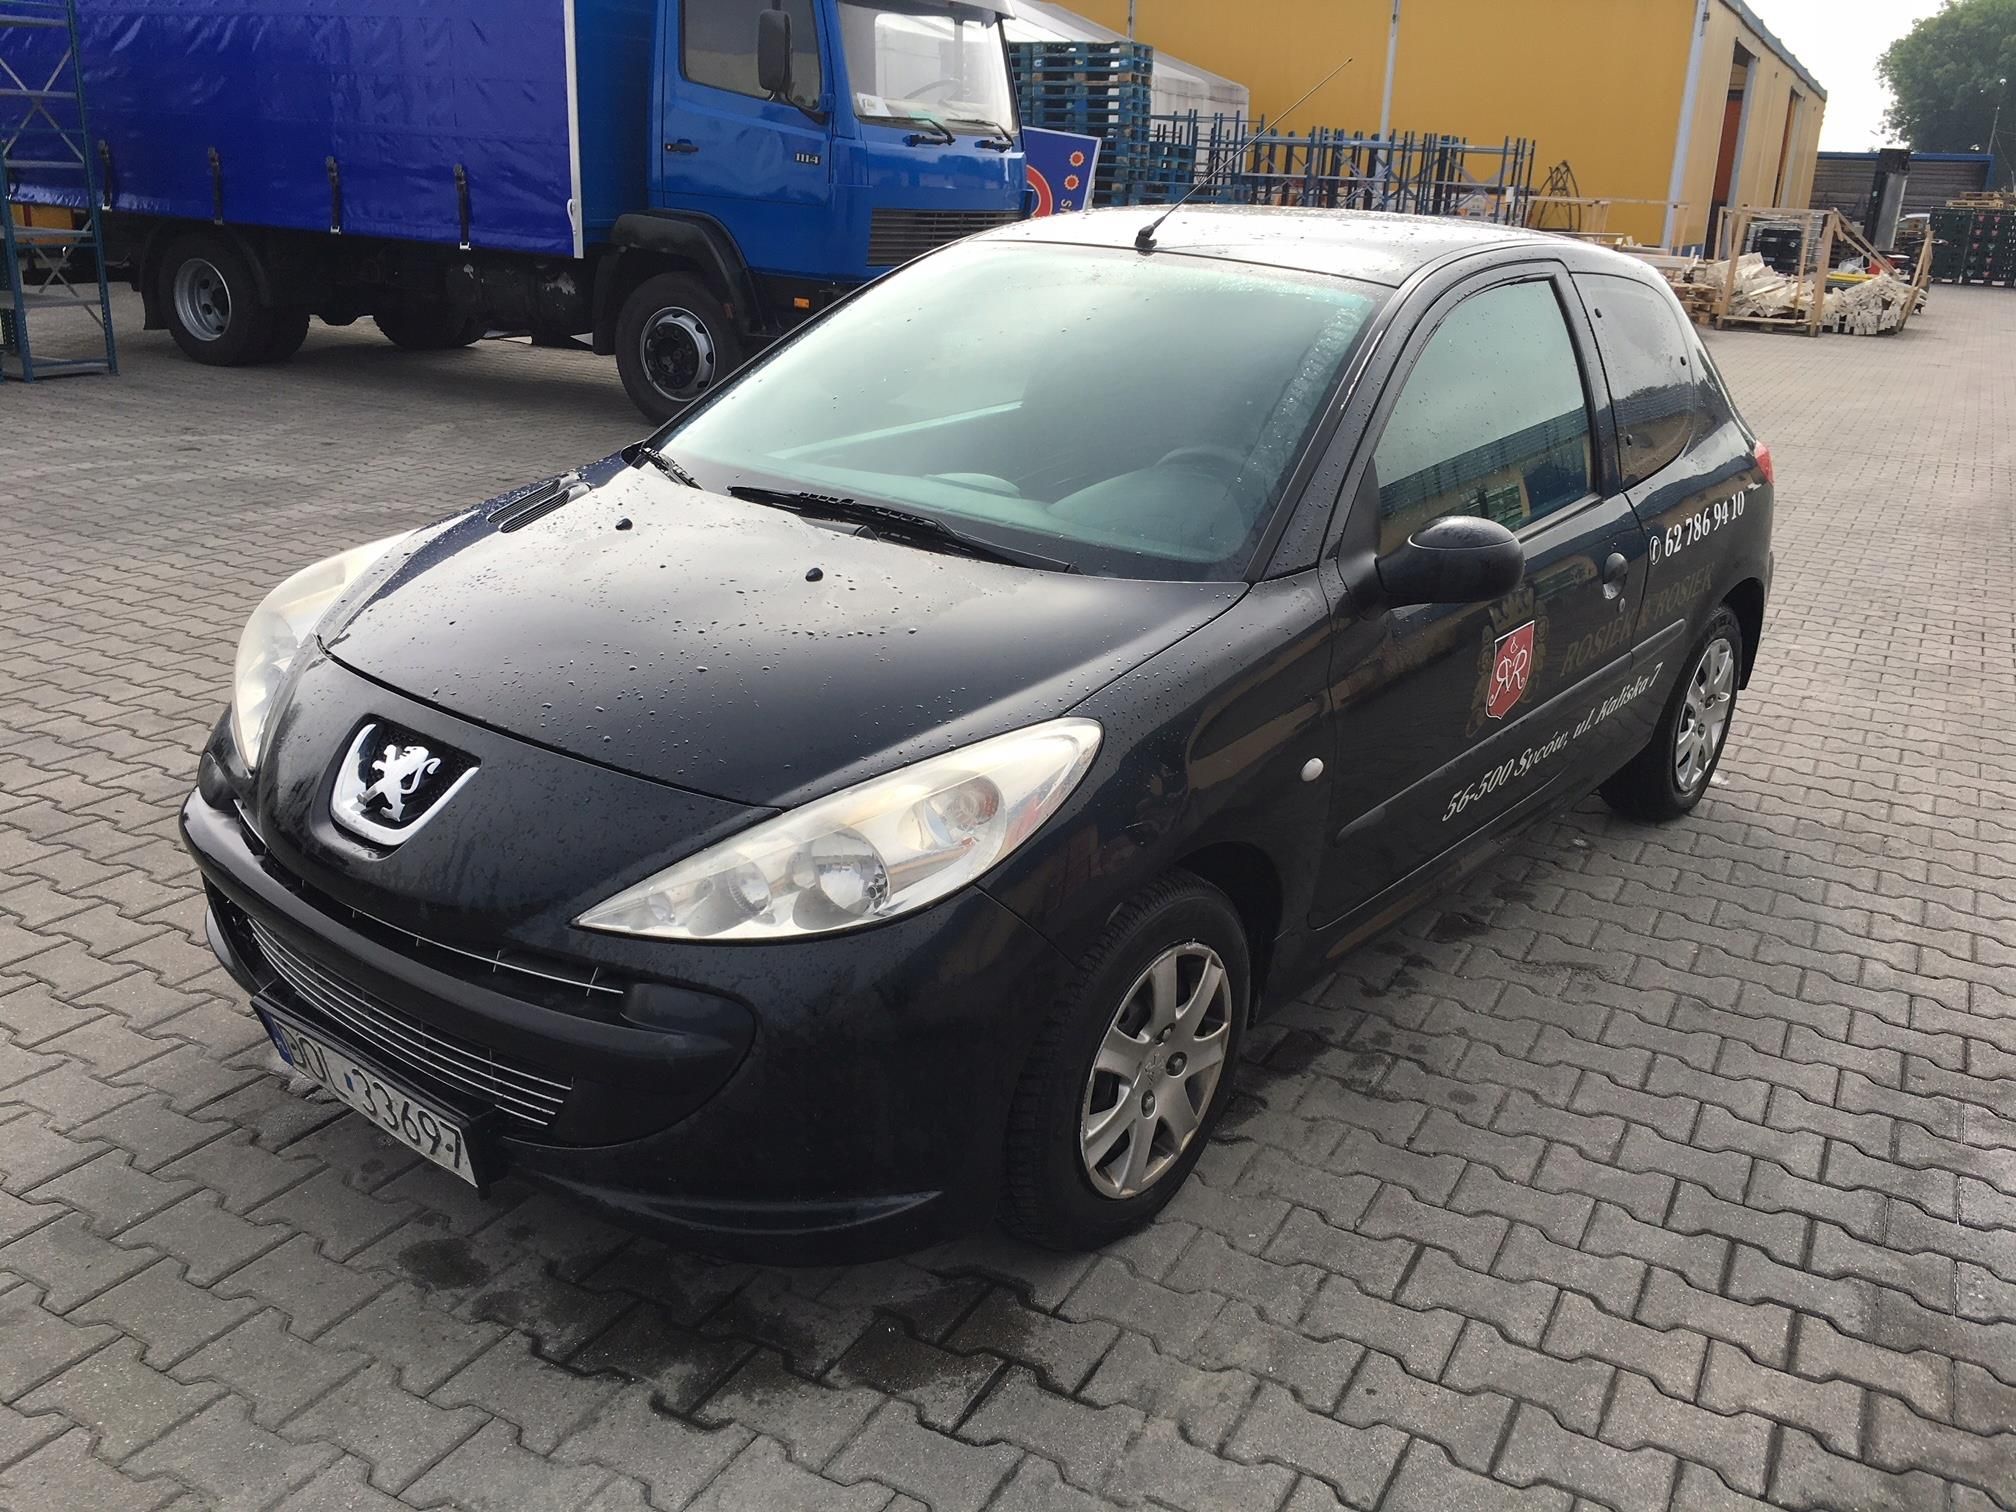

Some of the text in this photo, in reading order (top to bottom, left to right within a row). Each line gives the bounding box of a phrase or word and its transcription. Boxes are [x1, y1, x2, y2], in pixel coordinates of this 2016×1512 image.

[796, 153, 819, 165] 1114
[1665, 490, 1745, 557] 62 786 94 10
[1442, 757, 1514, 822] 56-500
[1573, 707, 1596, 739] ul.
[1595, 676, 1650, 725] Kaliska
[1649, 661, 1664, 688] 7
[350, 1068, 462, 1170] 33697
